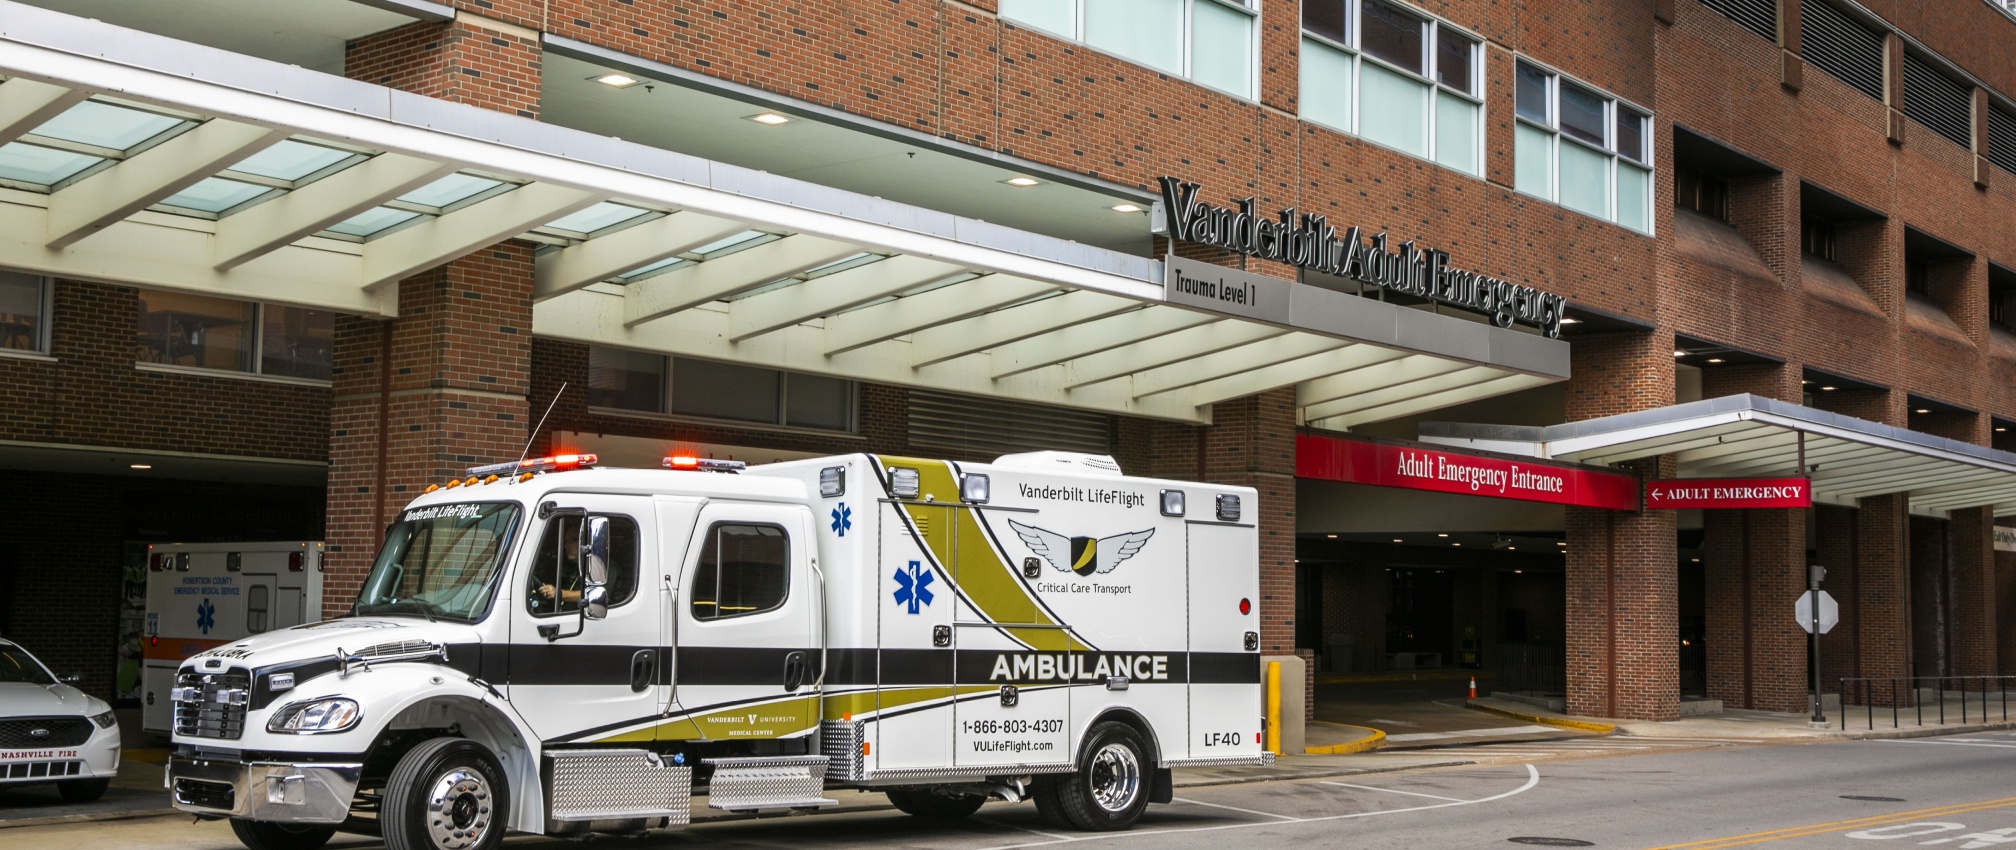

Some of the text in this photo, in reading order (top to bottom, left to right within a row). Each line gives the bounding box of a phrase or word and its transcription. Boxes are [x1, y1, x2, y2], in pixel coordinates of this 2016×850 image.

[1157, 176, 1566, 339] Vanderbilt Adult Emergency
[1175, 268, 1256, 307] Trauma Level 1
[1397, 451, 1563, 494] Adult Emergency Entrance
[1019, 483, 1145, 509] Vanderbilt LifeFlight
[1666, 486, 1802, 500] ADULT EMERGENCY
[404, 503, 481, 522] Vanderbilt LifeFlight
[182, 577, 233, 585] ROBERTSON COUNTY
[174, 587, 240, 596] EMERGENCY MEDICAL SERVICE
[1037, 582, 1132, 596] Critical Care Transport
[147, 620, 157, 634] 11
[989, 654, 1168, 681] AMBULANCE
[962, 719, 1064, 735] 1-866-803-4307
[973, 739, 1053, 753] VULifeFlight.com
[1205, 732, 1241, 747] LF40
[1, 751, 54, 759] NASHVILLE
